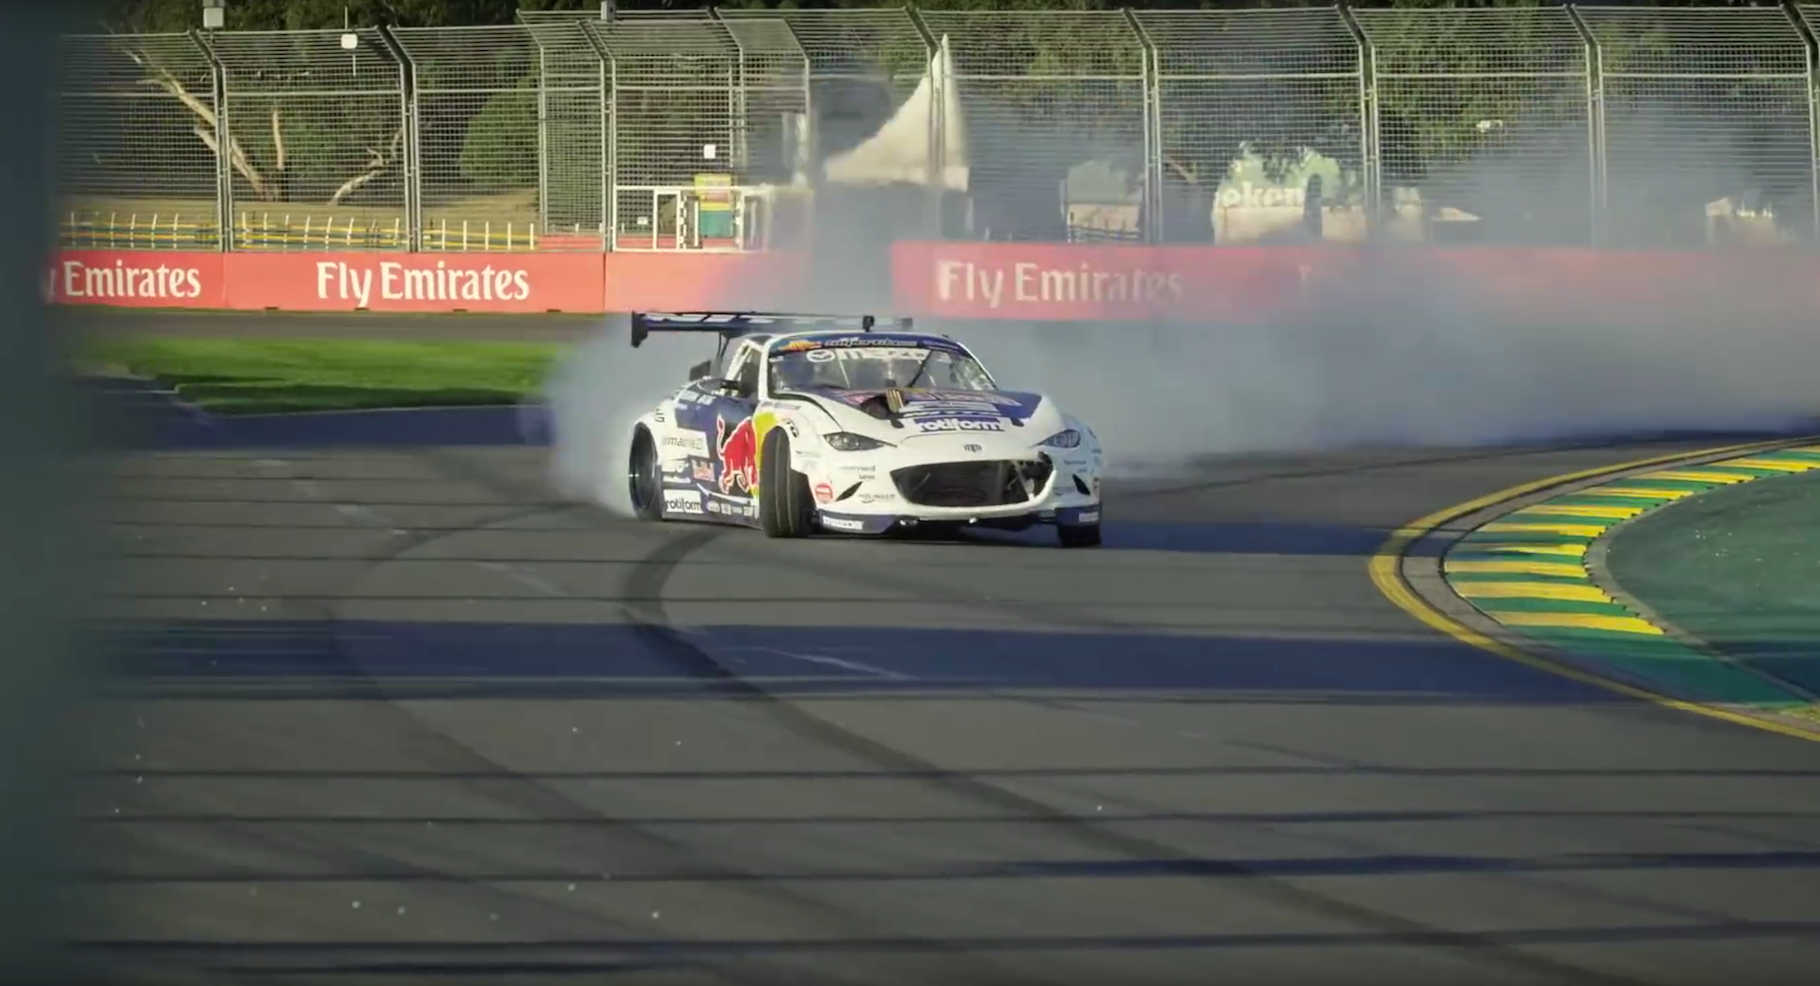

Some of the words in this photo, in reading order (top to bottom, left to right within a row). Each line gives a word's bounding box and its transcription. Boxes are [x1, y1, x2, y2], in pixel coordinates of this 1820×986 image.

[64, 259, 201, 298] Emirates
[316, 261, 373, 308] Fly
[380, 260, 530, 301] Emirates
[937, 258, 1003, 308] Fly
[1014, 261, 1184, 302] Emirates
[919, 418, 1002, 432] rotiform
